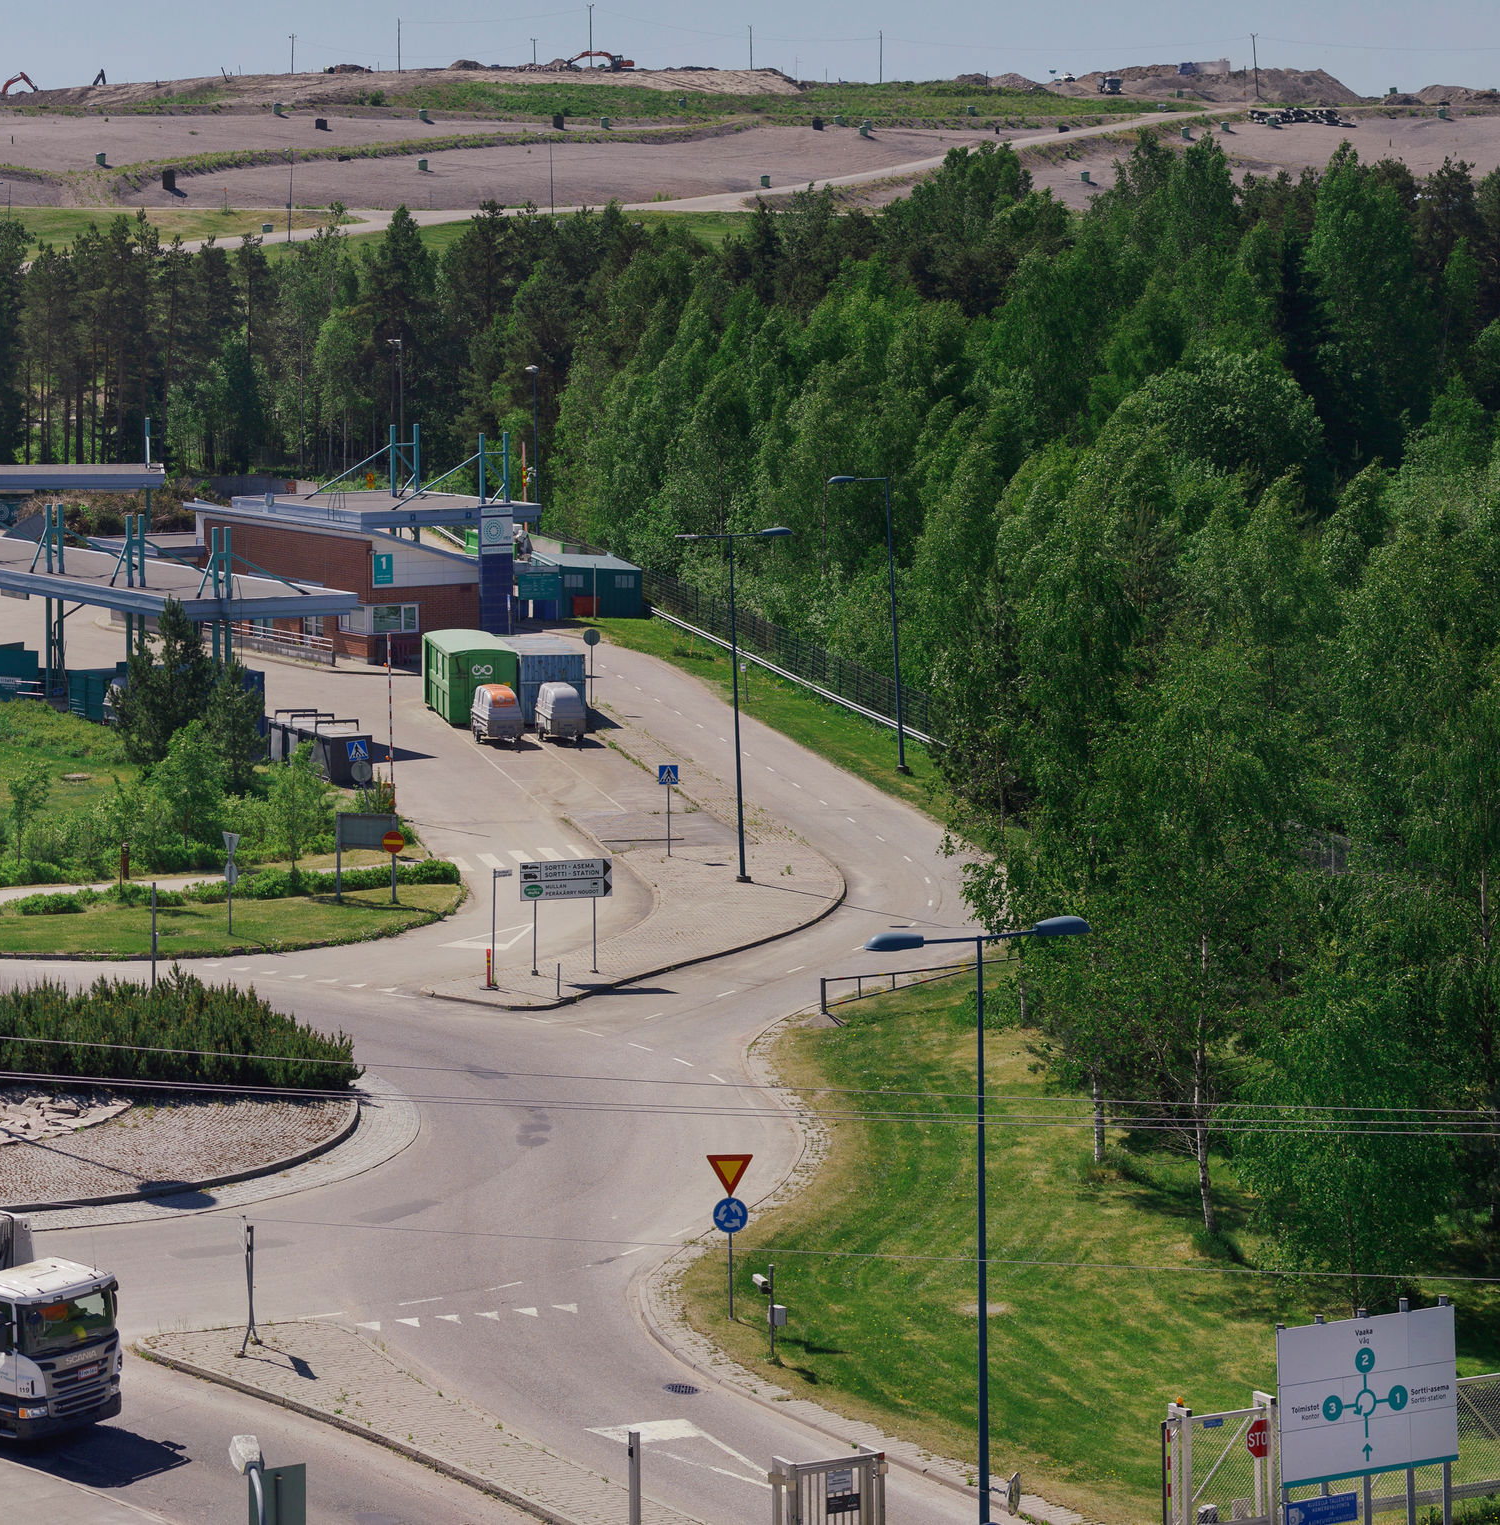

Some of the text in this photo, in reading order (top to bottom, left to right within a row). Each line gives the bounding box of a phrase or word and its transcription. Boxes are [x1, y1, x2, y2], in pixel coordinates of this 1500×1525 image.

[381, 556, 386, 570] 1
[1355, 1328, 1373, 1337] Vaaka
[1358, 1337, 1370, 1345] Våg
[65, 1350, 98, 1366] SCANIA
[1361, 1354, 1369, 1366] 2
[1410, 1384, 1450, 1396] Sortti-asema
[1395, 1392, 1400, 1404] 1
[1410, 1393, 1447, 1405] Sortti-station
[1291, 1404, 1320, 1414] Toimistot
[1328, 1402, 1337, 1414] 3
[1301, 1413, 1320, 1421] Kontor
[1248, 1432, 1267, 1448] STO
